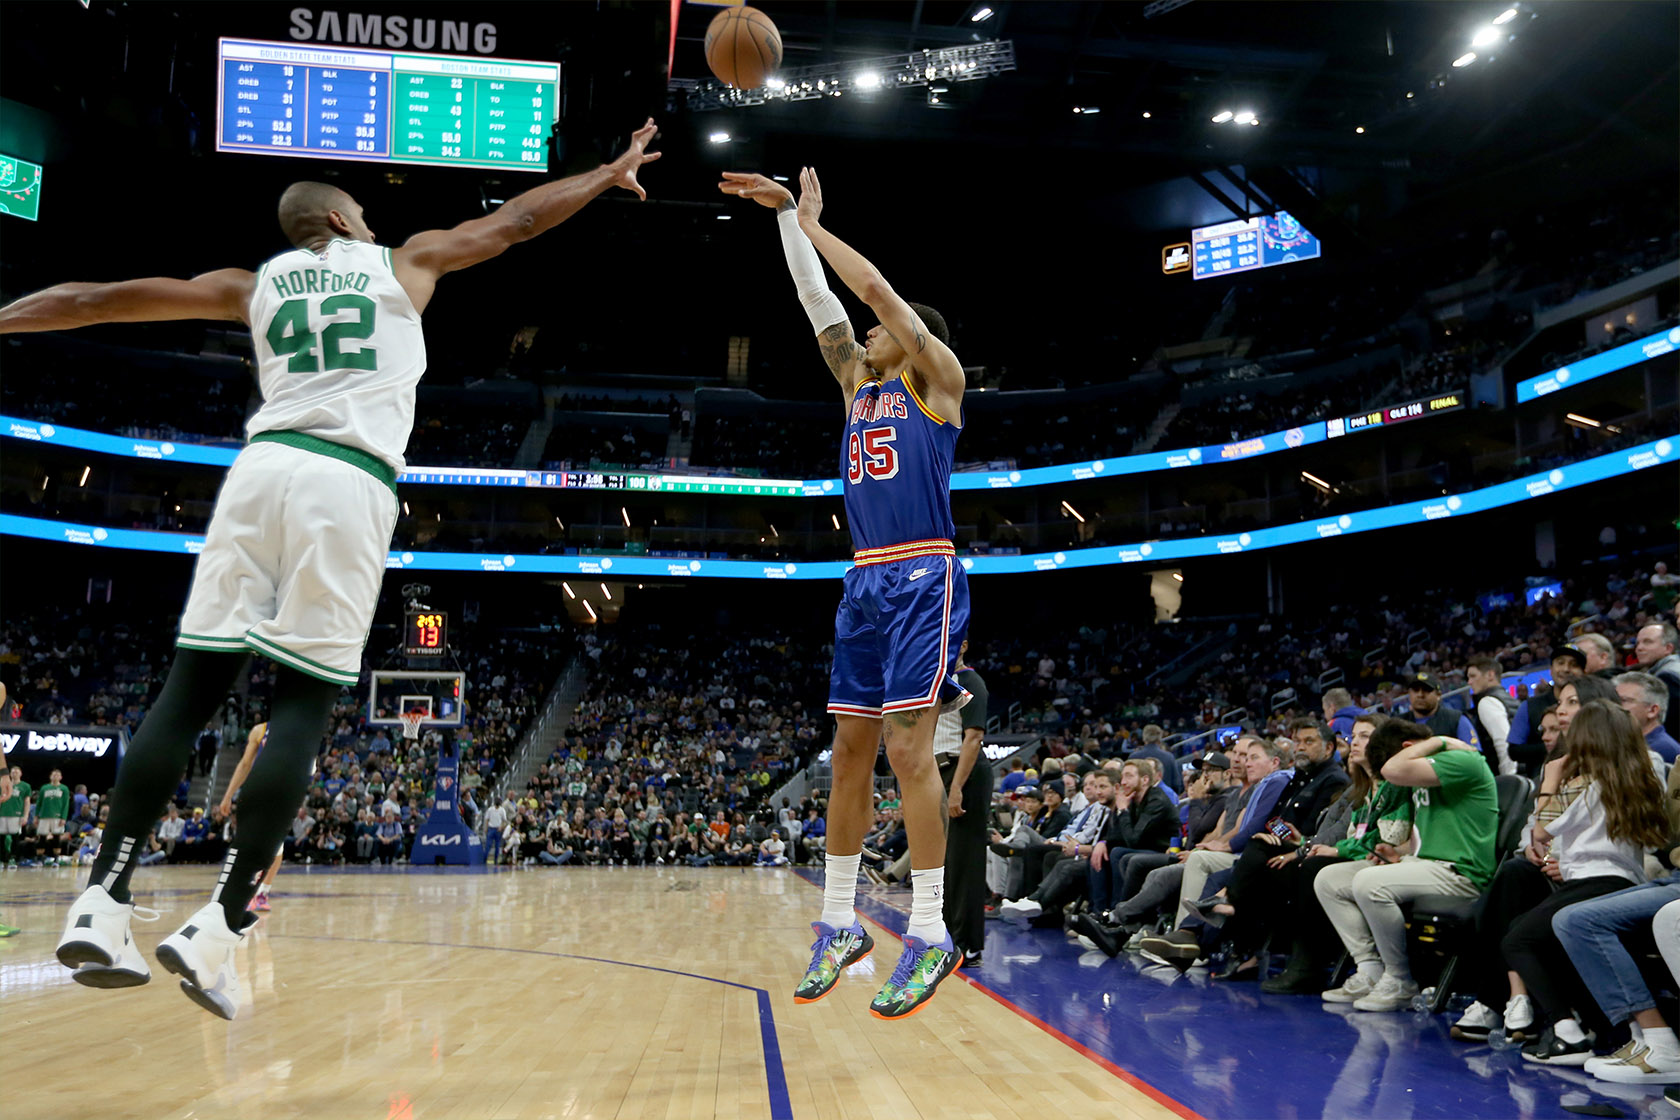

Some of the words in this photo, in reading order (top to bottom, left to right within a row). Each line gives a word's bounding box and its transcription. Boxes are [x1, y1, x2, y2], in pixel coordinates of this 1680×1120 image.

[289, 7, 497, 54] SAMSUNG
[260, 49, 288, 60] GOLDEN
[289, 51, 311, 61] STATE
[313, 53, 332, 63] TEAM
[334, 54, 356, 64] STATS
[238, 64, 254, 72] AST
[441, 63, 469, 73] BOSTON
[470, 65, 489, 75] TEAM
[490, 66, 512, 76] STATS
[322, 71, 338, 79] BLK
[369, 72, 377, 83] 4
[409, 77, 424, 85] AST
[238, 78, 259, 87] OREB
[286, 80, 294, 91] 7
[322, 84, 333, 92] TO
[490, 82, 504, 91] BLK
[536, 84, 542, 94] 4
[237, 92, 259, 101] DREB
[282, 94, 293, 104] 31
[490, 96, 501, 104] TO
[237, 106, 252, 114] STL
[369, 100, 376, 110] 7
[321, 112, 339, 120] PITP
[409, 118, 422, 126] STL
[455, 119, 461, 130] 4
[271, 135, 292, 146] 22.2
[320, 140, 337, 148] FT%
[272, 269, 370, 299] HORFORD
[266, 294, 378, 373] 42
[1430, 396, 1458, 410] FINAL
[10, 423, 37, 434] Johnson
[14, 430, 42, 441] Controls
[848, 426, 899, 485] 95
[546, 474, 557, 485] 81
[629, 477, 646, 489] 100
[417, 614, 443, 628] 2:57
[419, 626, 439, 647] 13
[27, 730, 112, 757] betway
